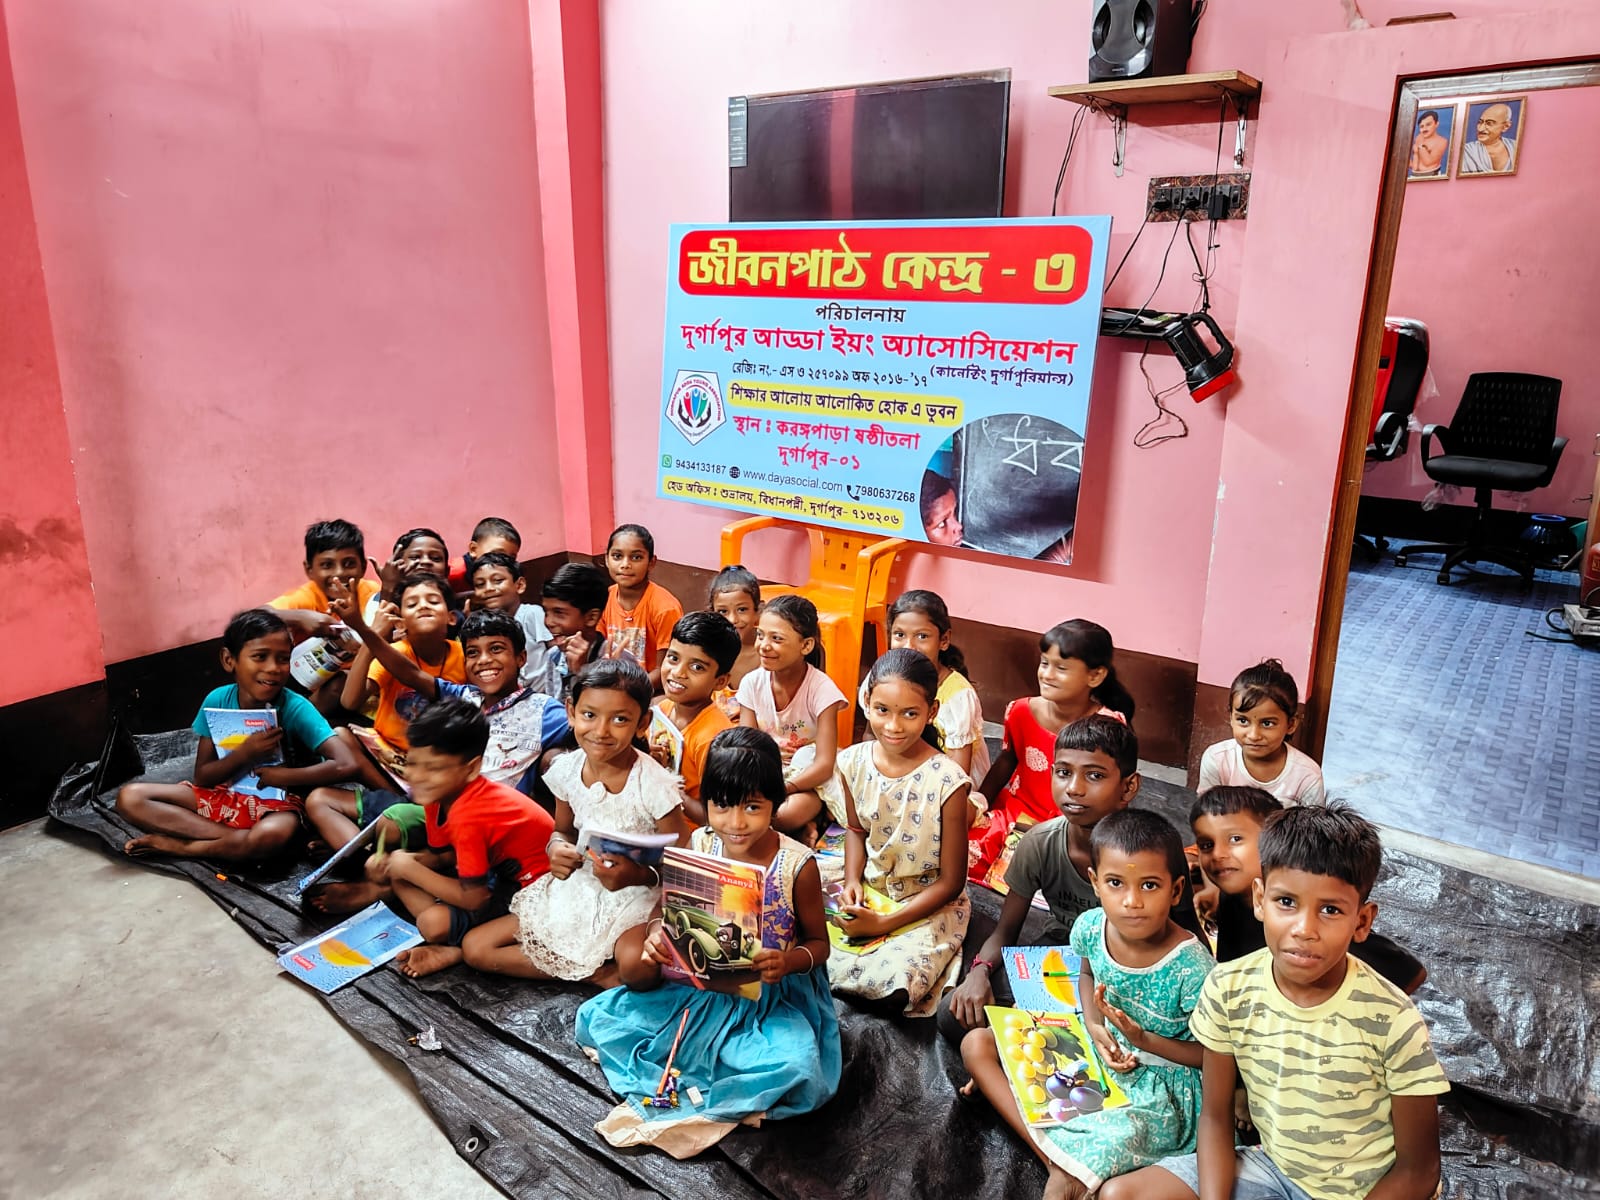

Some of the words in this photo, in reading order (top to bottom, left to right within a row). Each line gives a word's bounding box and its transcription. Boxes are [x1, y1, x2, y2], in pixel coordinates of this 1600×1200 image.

[688, 232, 872, 289] জীবনপাঠ
[882, 252, 990, 294] কেন্দ্র
[1033, 253, 1076, 292] ৩
[816, 302, 906, 322] পরিচালনায়
[680, 318, 748, 353] দুর্গাপুর
[753, 326, 825, 352] আড্ডা
[828, 325, 874, 357] ইয়ং
[881, 330, 1078, 365] অ্যাসোসিয়েশন
[779, 365, 795, 377] এস
[797, 367, 805, 377] ও
[808, 368, 849, 381] ২৫৭০৯৯
[852, 370, 870, 383] অফ
[730, 383, 766, 403] শিক্ষার
[770, 388, 811, 407] আলোয়
[815, 393, 874, 411] আলোকিত
[878, 398, 907, 416] হোক
[911, 402, 921, 417] এ
[925, 403, 957, 424] ভুবন
[733, 416, 762, 436] স্থান
[776, 420, 850, 445] করঙ্গপাড়া
[854, 424, 920, 450] ষষ্ঠীতলা
[675, 459, 727, 474] 9434133187
[778, 443, 860, 471] দুর্গাপুর-০১
[743, 469, 842, 492] www.dayasocial.com
[855, 485, 915, 502] 7980637268
[667, 480, 683, 492] হেড
[686, 481, 711, 495] অফিস
[852, 509, 899, 524] ৭১৩২০৬
